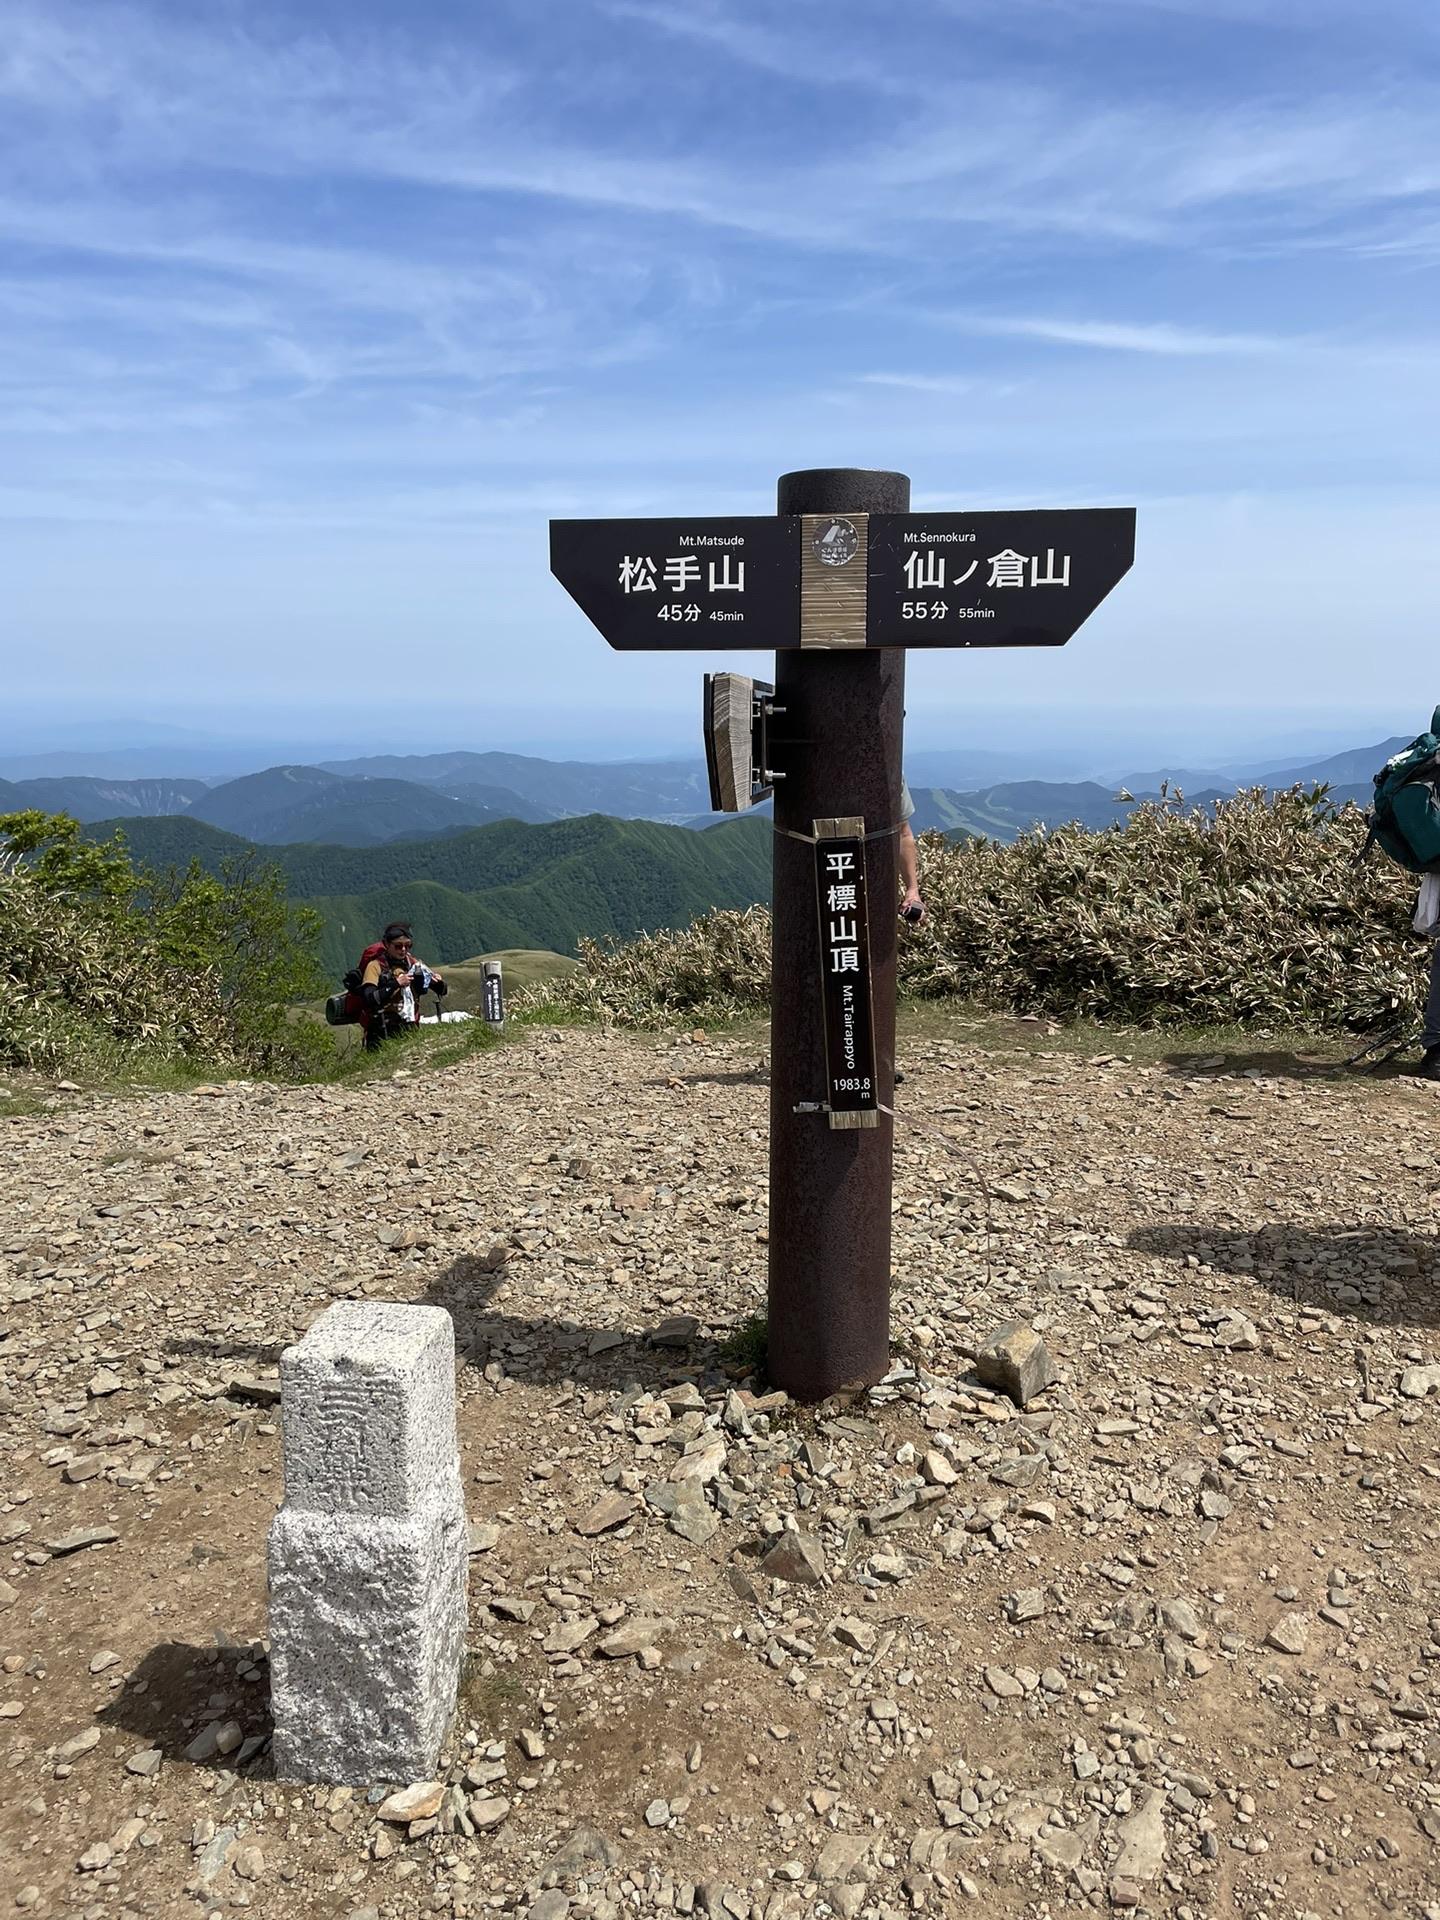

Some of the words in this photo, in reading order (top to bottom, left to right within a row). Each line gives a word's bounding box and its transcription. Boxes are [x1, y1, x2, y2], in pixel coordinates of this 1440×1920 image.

[680, 536, 744, 545] Mt.Matsude
[904, 532, 975, 542] Mt.Sennokura
[619, 555, 744, 592] 松手山
[903, 549, 1070, 586] 仙ノ倉山
[658, 604, 701, 621] 45分
[710, 611, 743, 621] 45min
[902, 601, 948, 619] 55分
[960, 608, 994, 618] 55min
[827, 853, 859, 972] 平標山頂
[843, 986, 854, 1069] Mt.Tairappyo
[834, 1078, 870, 1090] 1983.8
